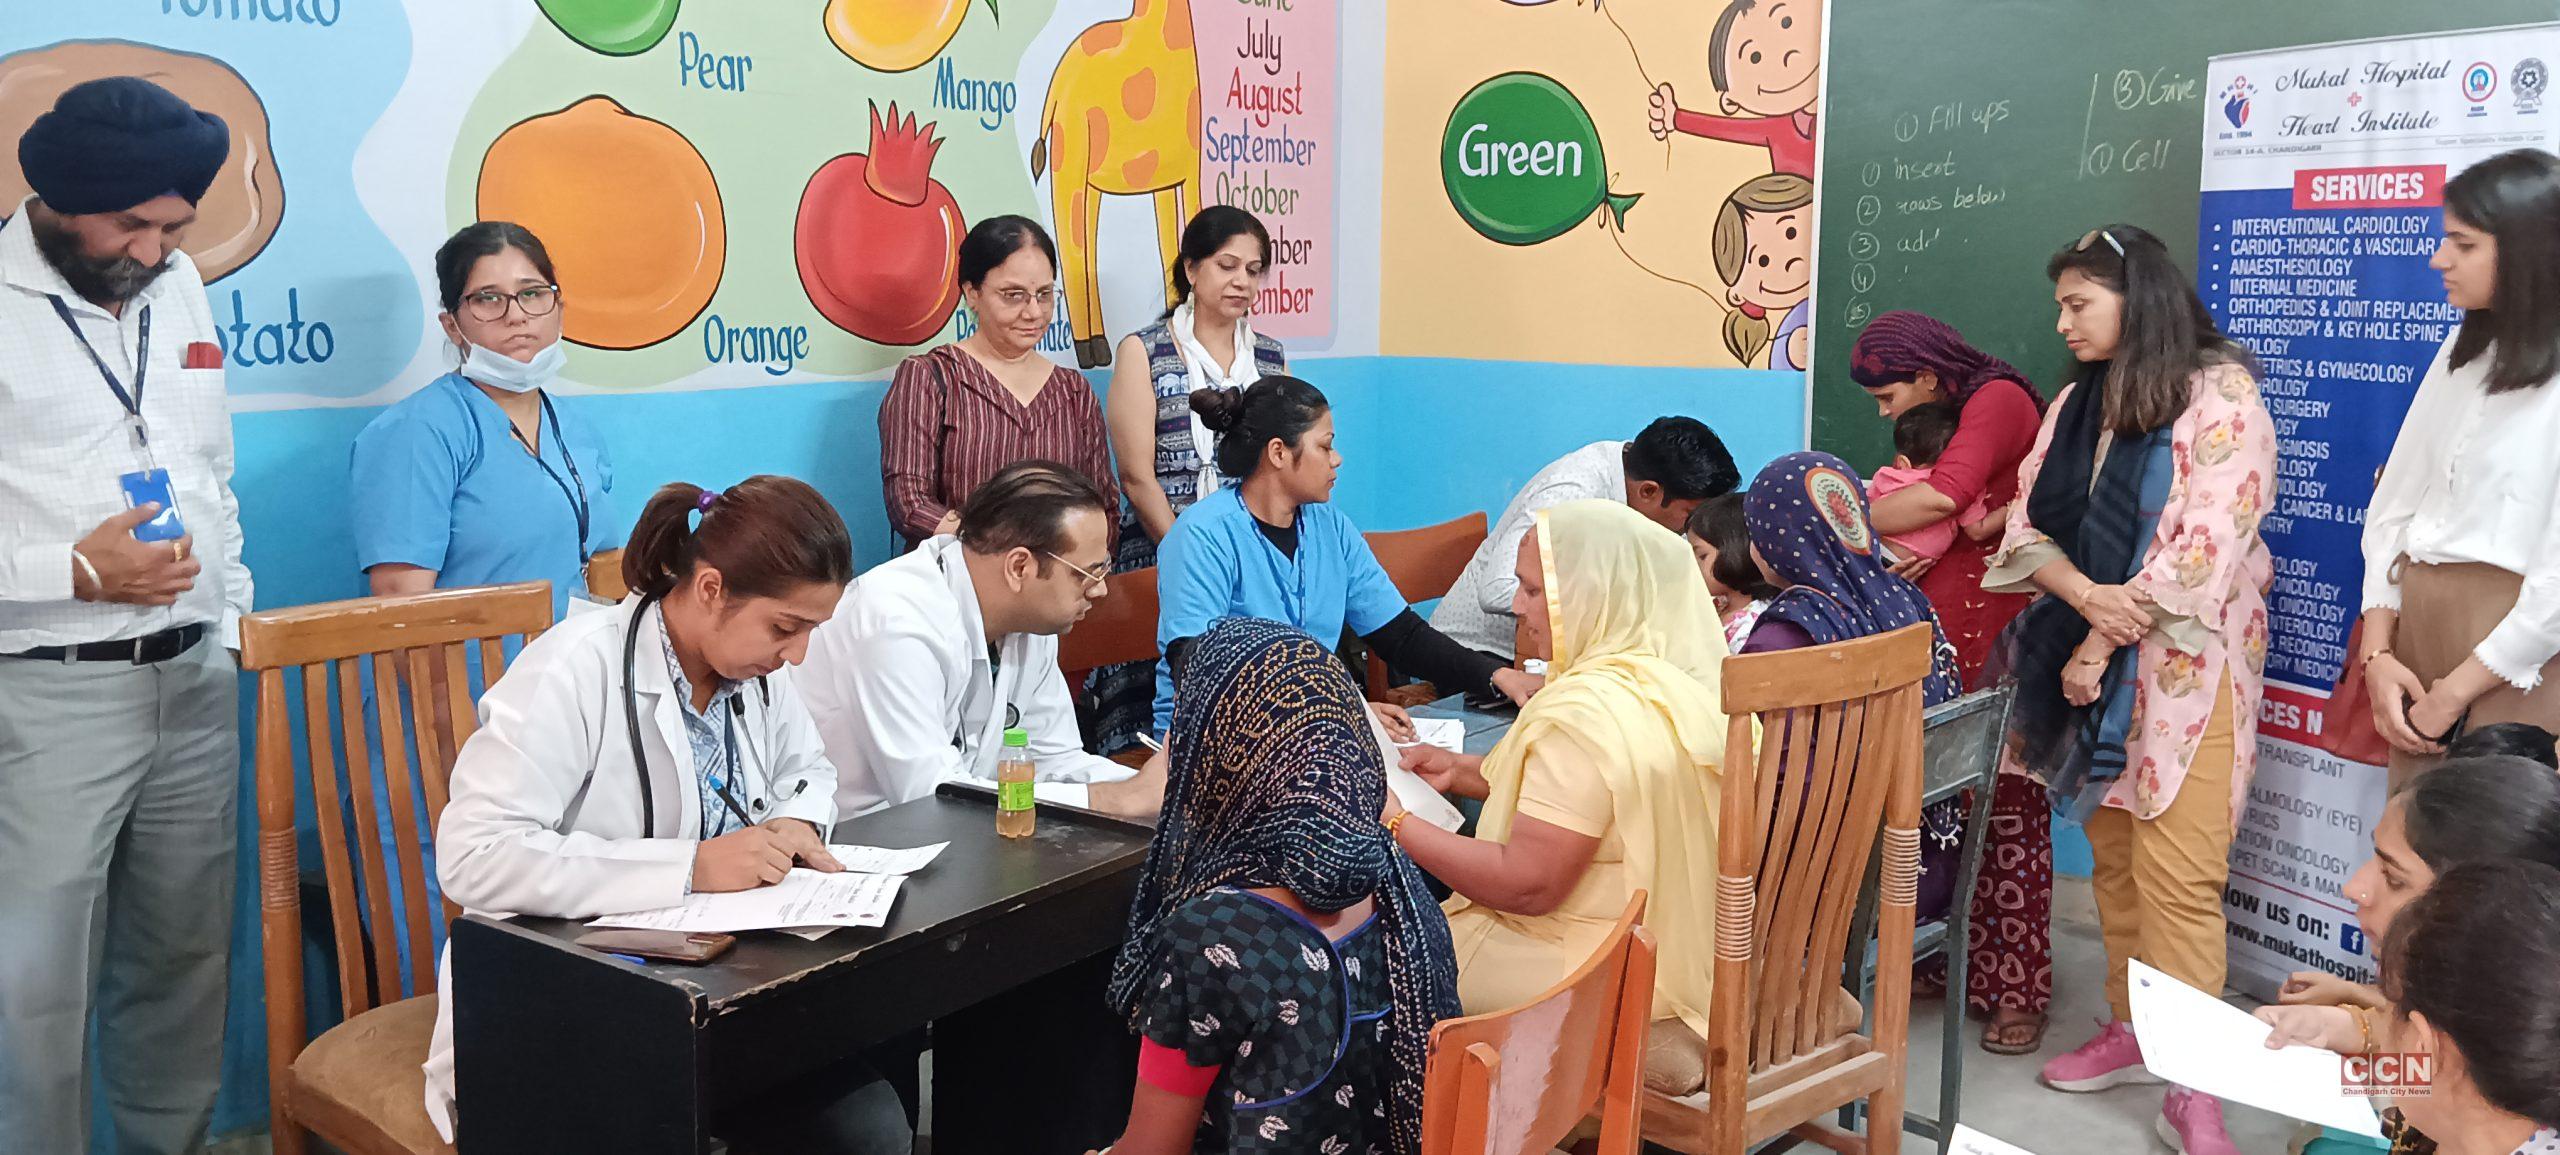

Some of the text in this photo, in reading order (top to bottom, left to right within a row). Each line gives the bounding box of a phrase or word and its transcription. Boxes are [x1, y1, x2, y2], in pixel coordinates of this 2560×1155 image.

[1237, 17, 1281, 75] July
[679, 31, 752, 92] Pear
[2360, 58, 2452, 88] Hospital
[933, 57, 1017, 131] Mango
[1227, 66, 1302, 129] August
[2278, 108, 2440, 137] Heart Institute
[1206, 116, 1316, 179] September
[1458, 124, 1582, 177] Green
[1216, 169, 1299, 216] October
[2310, 172, 2424, 202] SERVICES
[2232, 216, 2430, 236] INTERVENTIONAL CARDIOLOGY
[2231, 238, 2350, 256] CARDIO-THORACIC
[2353, 238, 2362, 256] &
[2365, 237, 2435, 256] VASCULAR
[2229, 258, 2353, 276] ANAESTHESIOLOGY
[2229, 278, 2357, 297] INTERNAL MEDICINE
[2228, 298, 2317, 316] ORTHOPEDICS
[2320, 299, 2330, 317] &
[2333, 300, 2371, 318] JOINT
[2227, 317, 2320, 336] ARTHROSCOPY
[2323, 320, 2334, 338] &
[2338, 321, 2362, 338] KEY
[2364, 322, 2401, 340] HOLE
[2403, 323, 2444, 342] SPINE
[704, 314, 810, 376] Orange
[2304, 360, 2315, 378] &
[2318, 361, 2415, 384] GYNAECOLOGY
[2273, 400, 2331, 418] SURGERY
[2281, 498, 2332, 520] CANCER
[2335, 505, 2345, 522] &
[2279, 596, 2347, 623] ONCOLOGY
[2256, 741, 2346, 779] TRANSPLANT
[2327, 810, 2363, 835] (EYE)
[2262, 857, 2297, 882] SCAN
[2300, 872, 2311, 888] &
[2275, 839, 2350, 876] ONCOLOGY
[2266, 902, 2290, 925] us
[2296, 913, 2330, 940] on:
